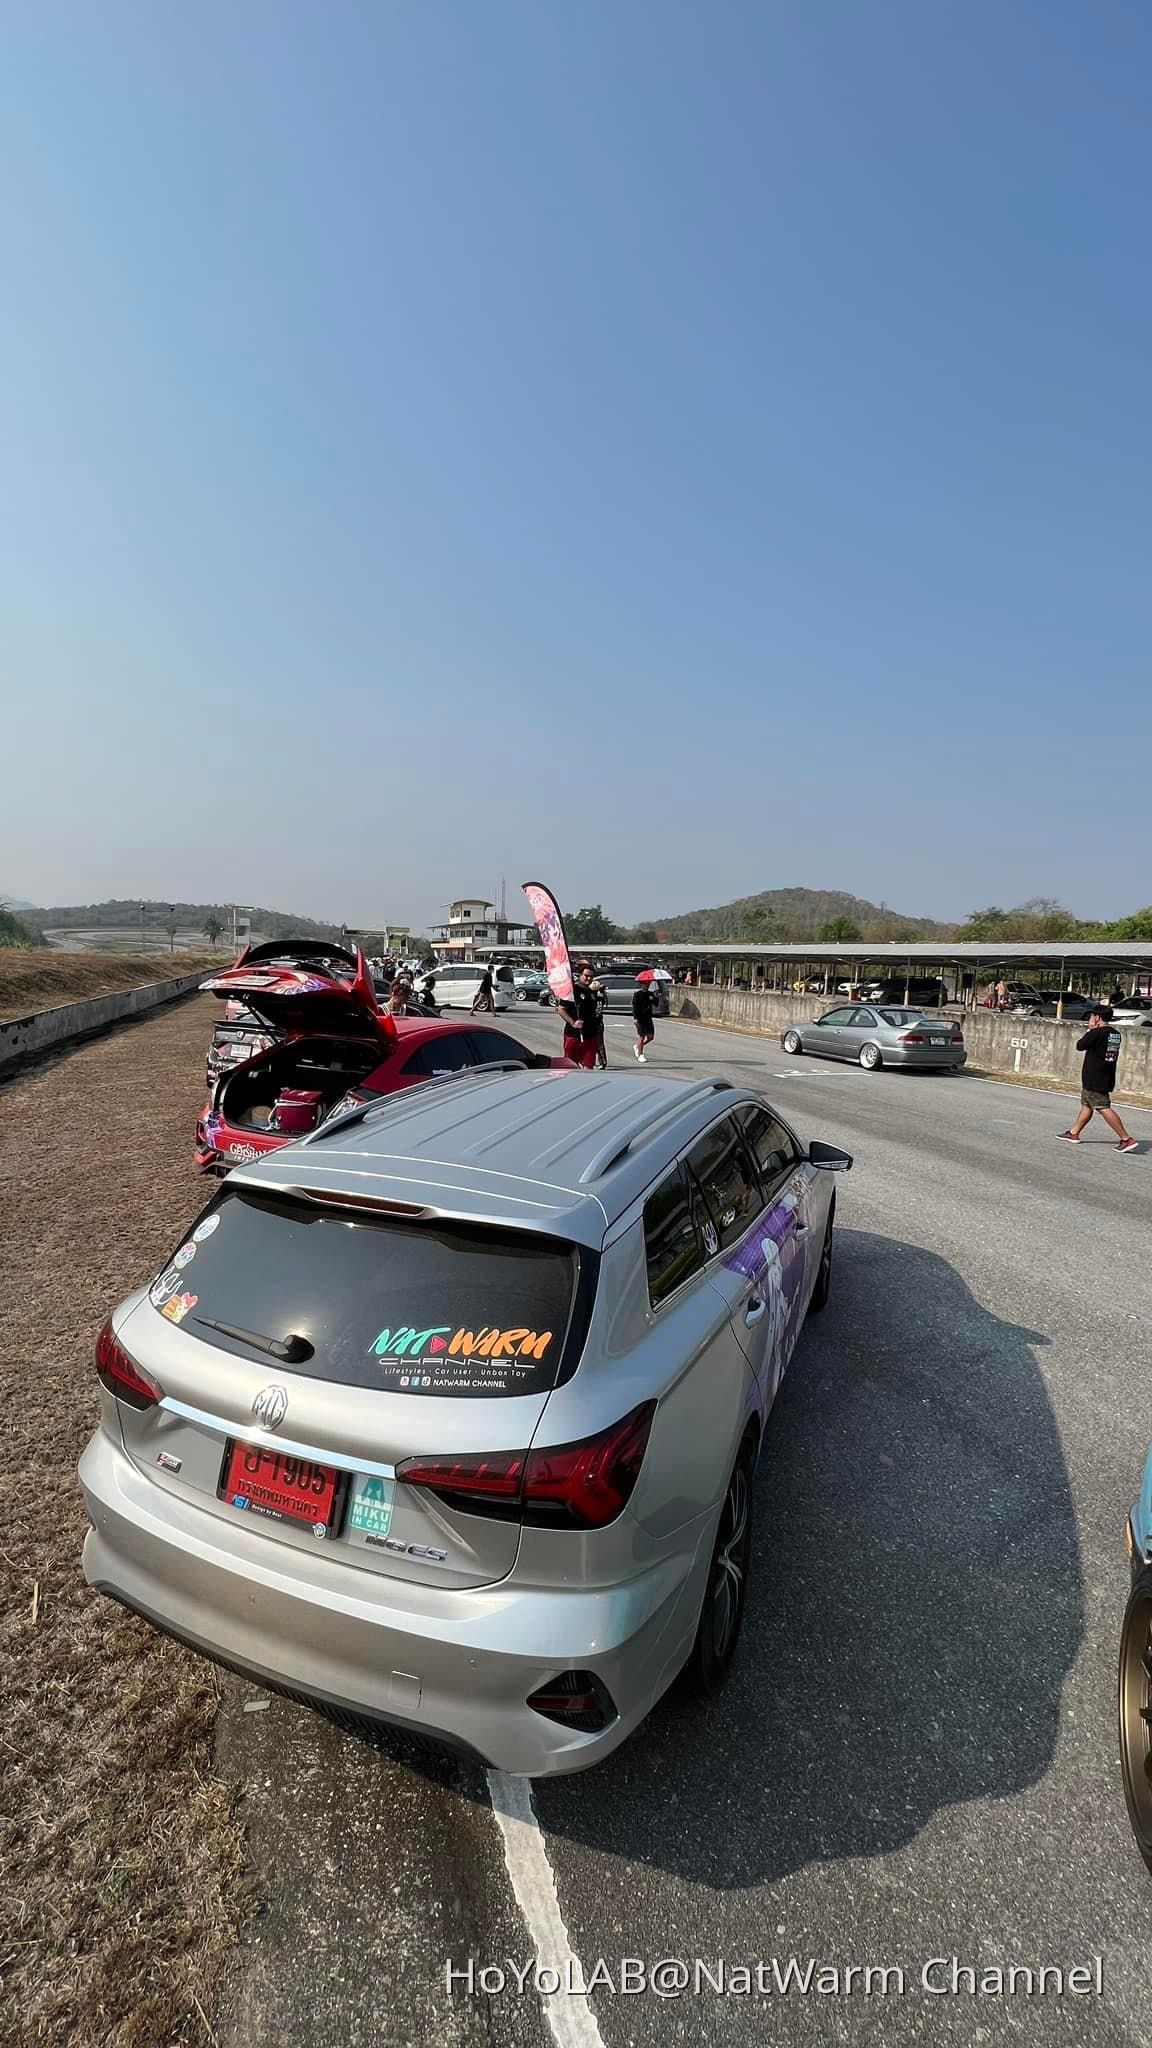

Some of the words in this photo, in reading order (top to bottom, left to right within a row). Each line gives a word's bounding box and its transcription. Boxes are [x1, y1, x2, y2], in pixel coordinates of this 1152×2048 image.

[367, 1326, 452, 1356] NAT
[448, 1327, 553, 1361] WARM
[378, 1357, 536, 1369] CHANNEL
[384, 1367, 426, 1376] Lifestyles
[435, 1368, 450, 1376] Car
[432, 1378, 470, 1388] NATWARM
[471, 1379, 507, 1389] CHANNEL
[353, 1503, 390, 1522] MIKU
[351, 1515, 362, 1525] IN
[366, 1519, 387, 1532] CAR
